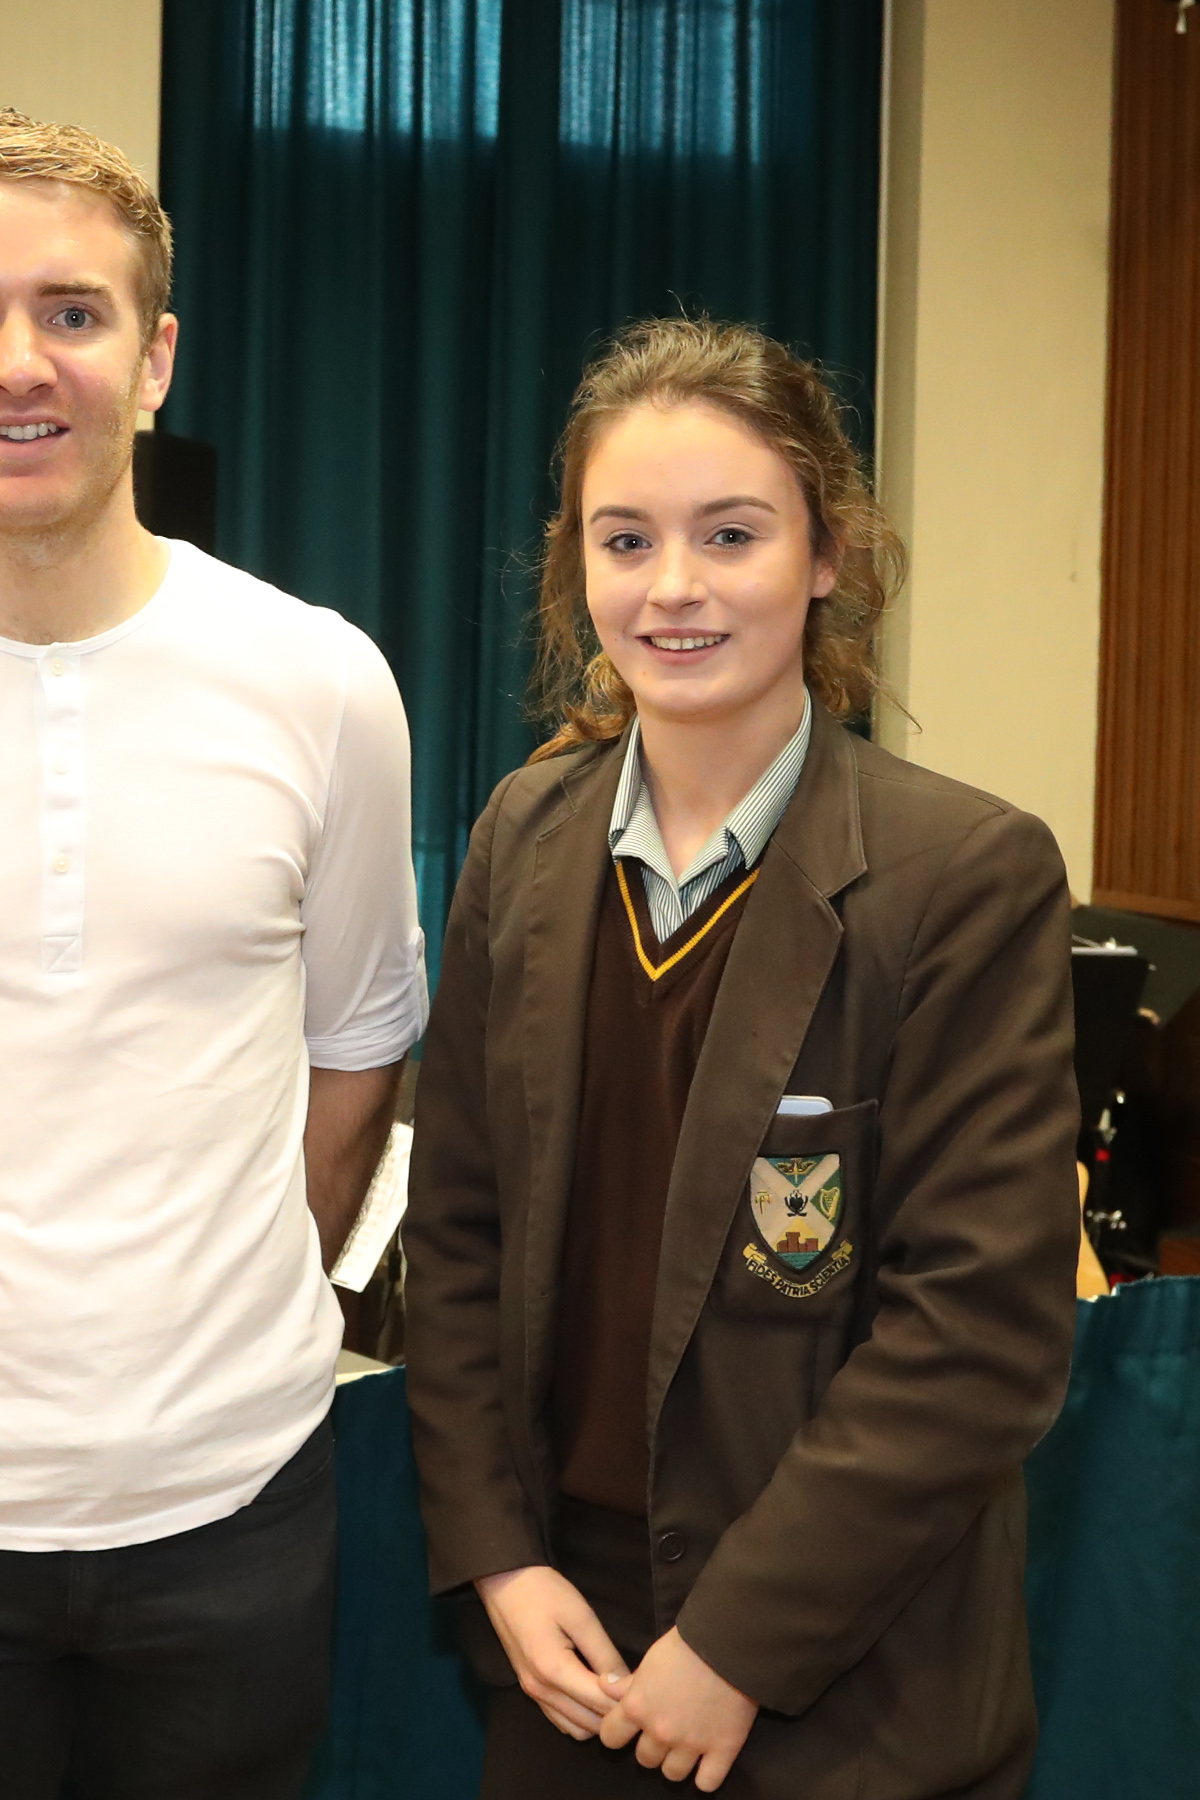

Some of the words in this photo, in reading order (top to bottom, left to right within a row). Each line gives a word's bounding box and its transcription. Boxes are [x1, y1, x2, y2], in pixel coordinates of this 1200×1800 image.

[748, 1259, 777, 1283] FIDES
[775, 1279, 811, 1296] PATRIA
[809, 1257, 849, 1292] SCIENTIA
